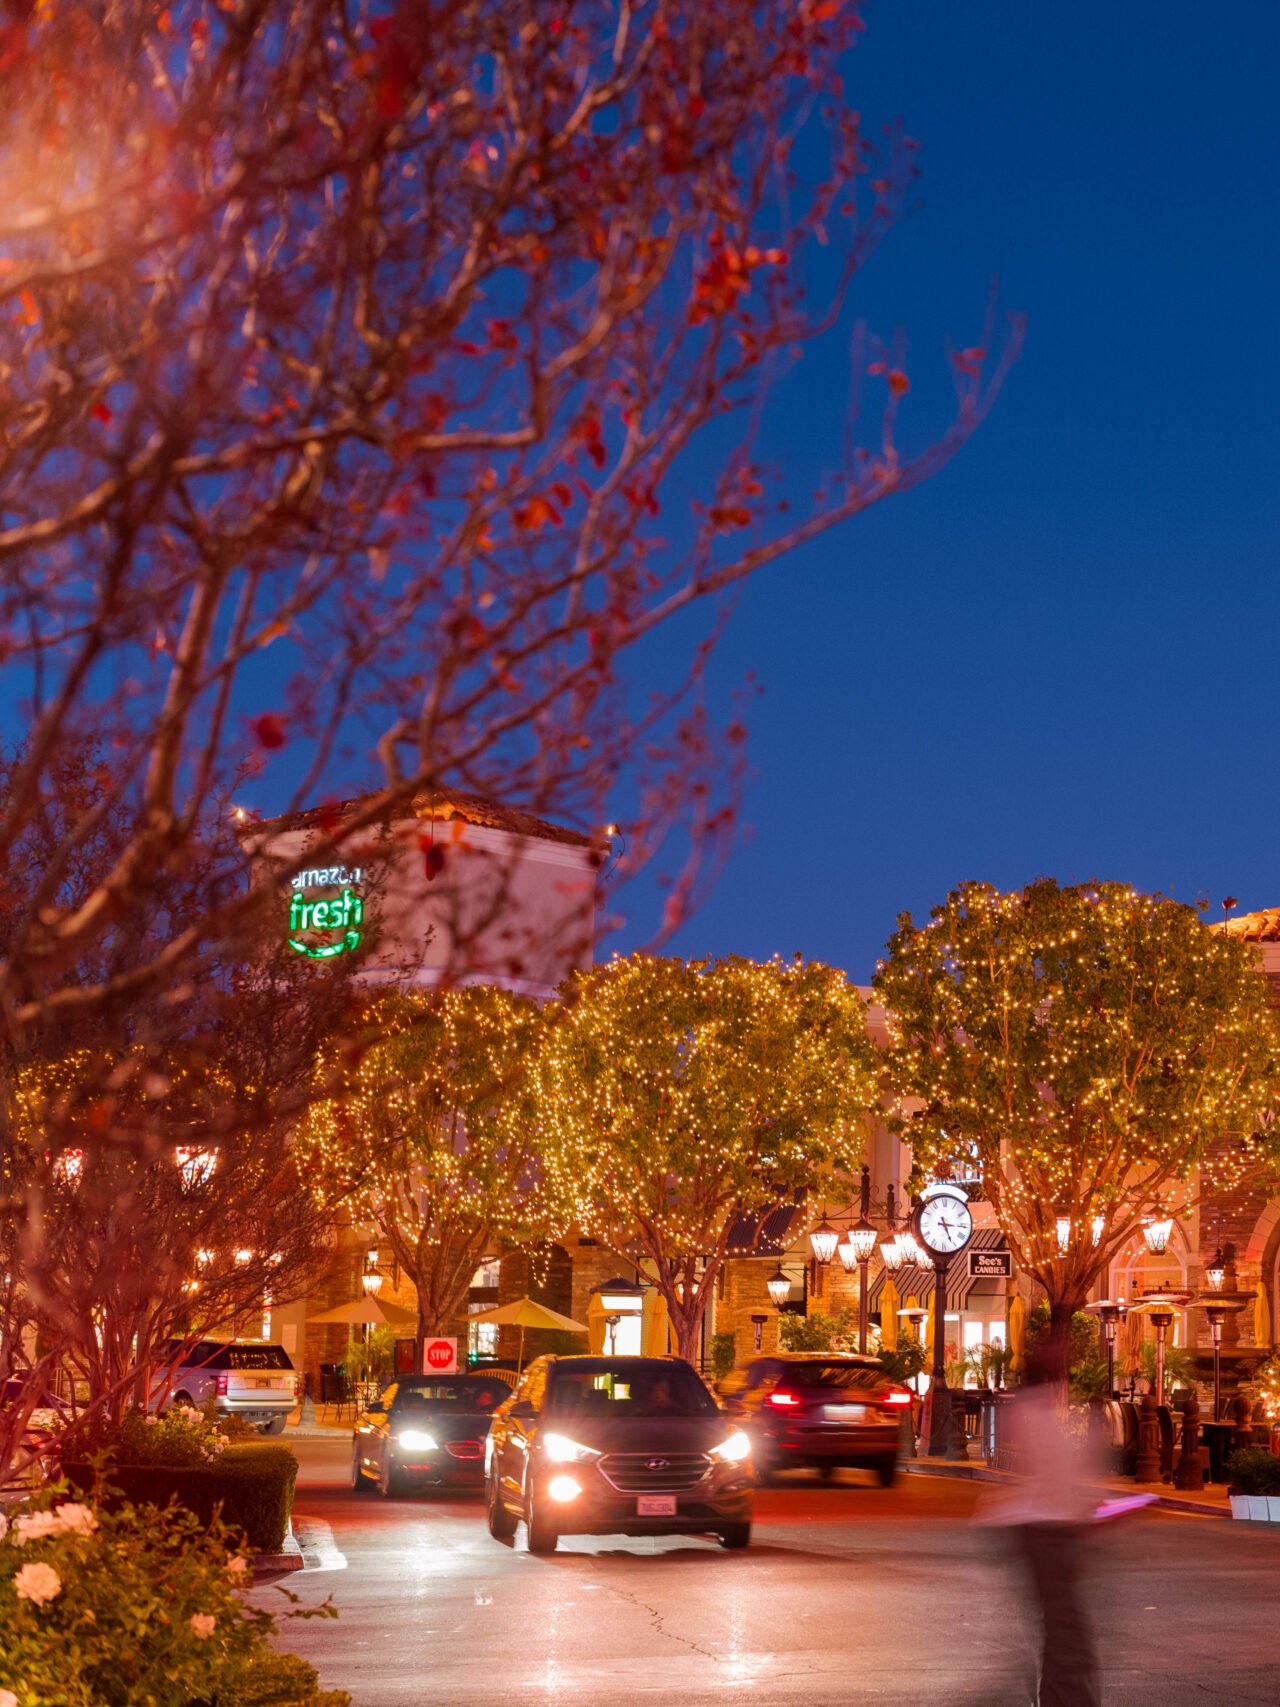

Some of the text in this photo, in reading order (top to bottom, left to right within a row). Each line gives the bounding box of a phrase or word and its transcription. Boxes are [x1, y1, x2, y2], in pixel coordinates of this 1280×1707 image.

[291, 866, 362, 889] amazon
[290, 889, 363, 930] fresh
[978, 1255, 1002, 1266] See's
[974, 1266, 1006, 1274] CANDIES
[430, 1349, 451, 1360] STOP
